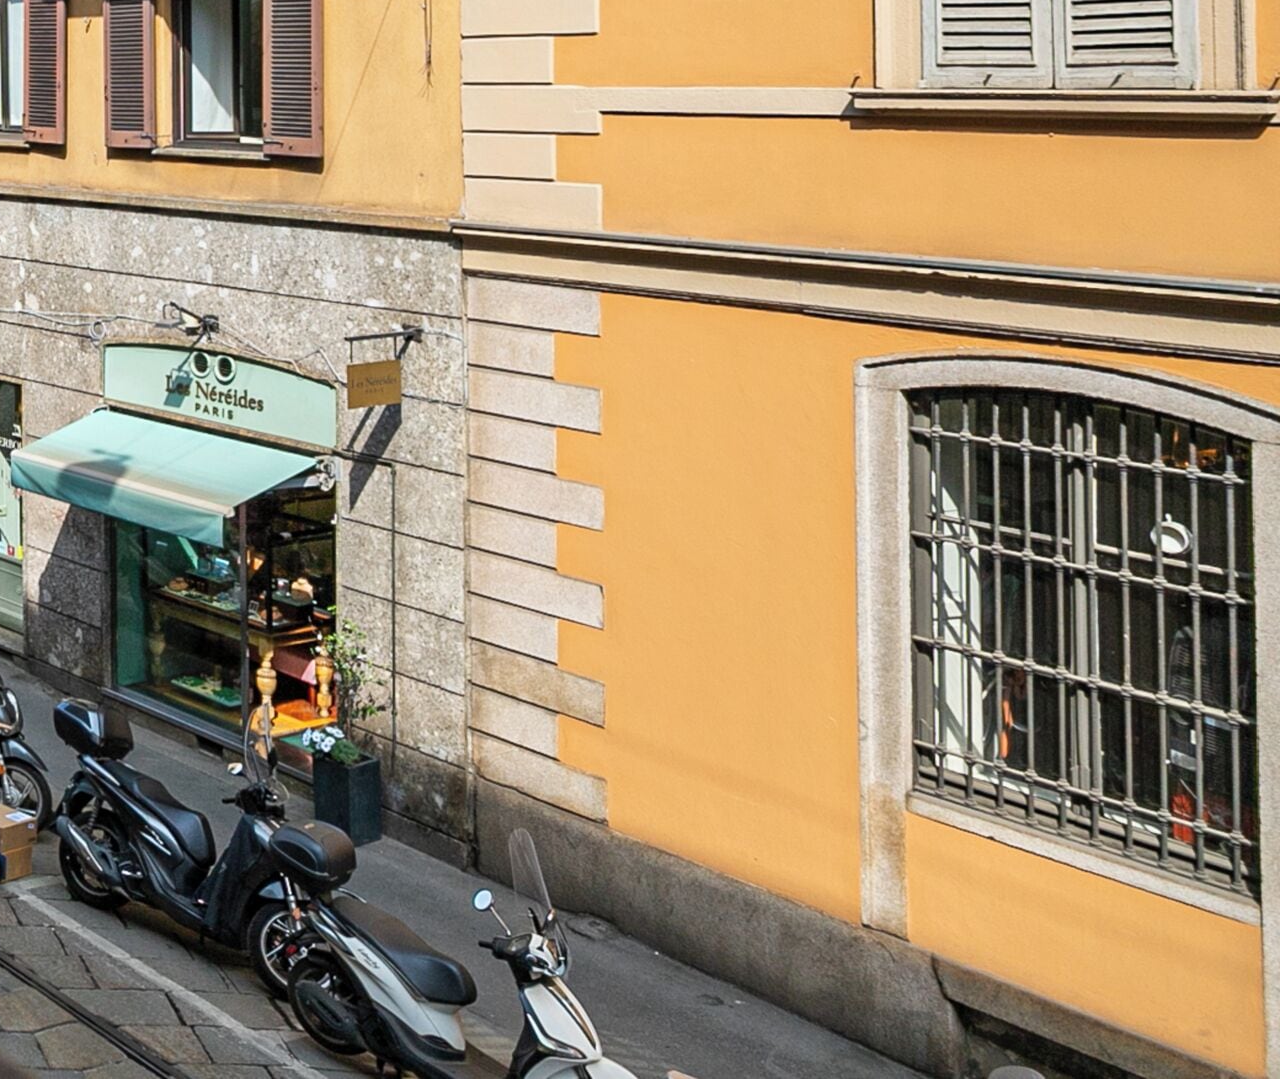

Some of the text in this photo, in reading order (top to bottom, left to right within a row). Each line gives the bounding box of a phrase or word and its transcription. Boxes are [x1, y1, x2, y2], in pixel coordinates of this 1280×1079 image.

[165, 374, 265, 412] Les Néréides
[194, 402, 234, 420] PARIS
